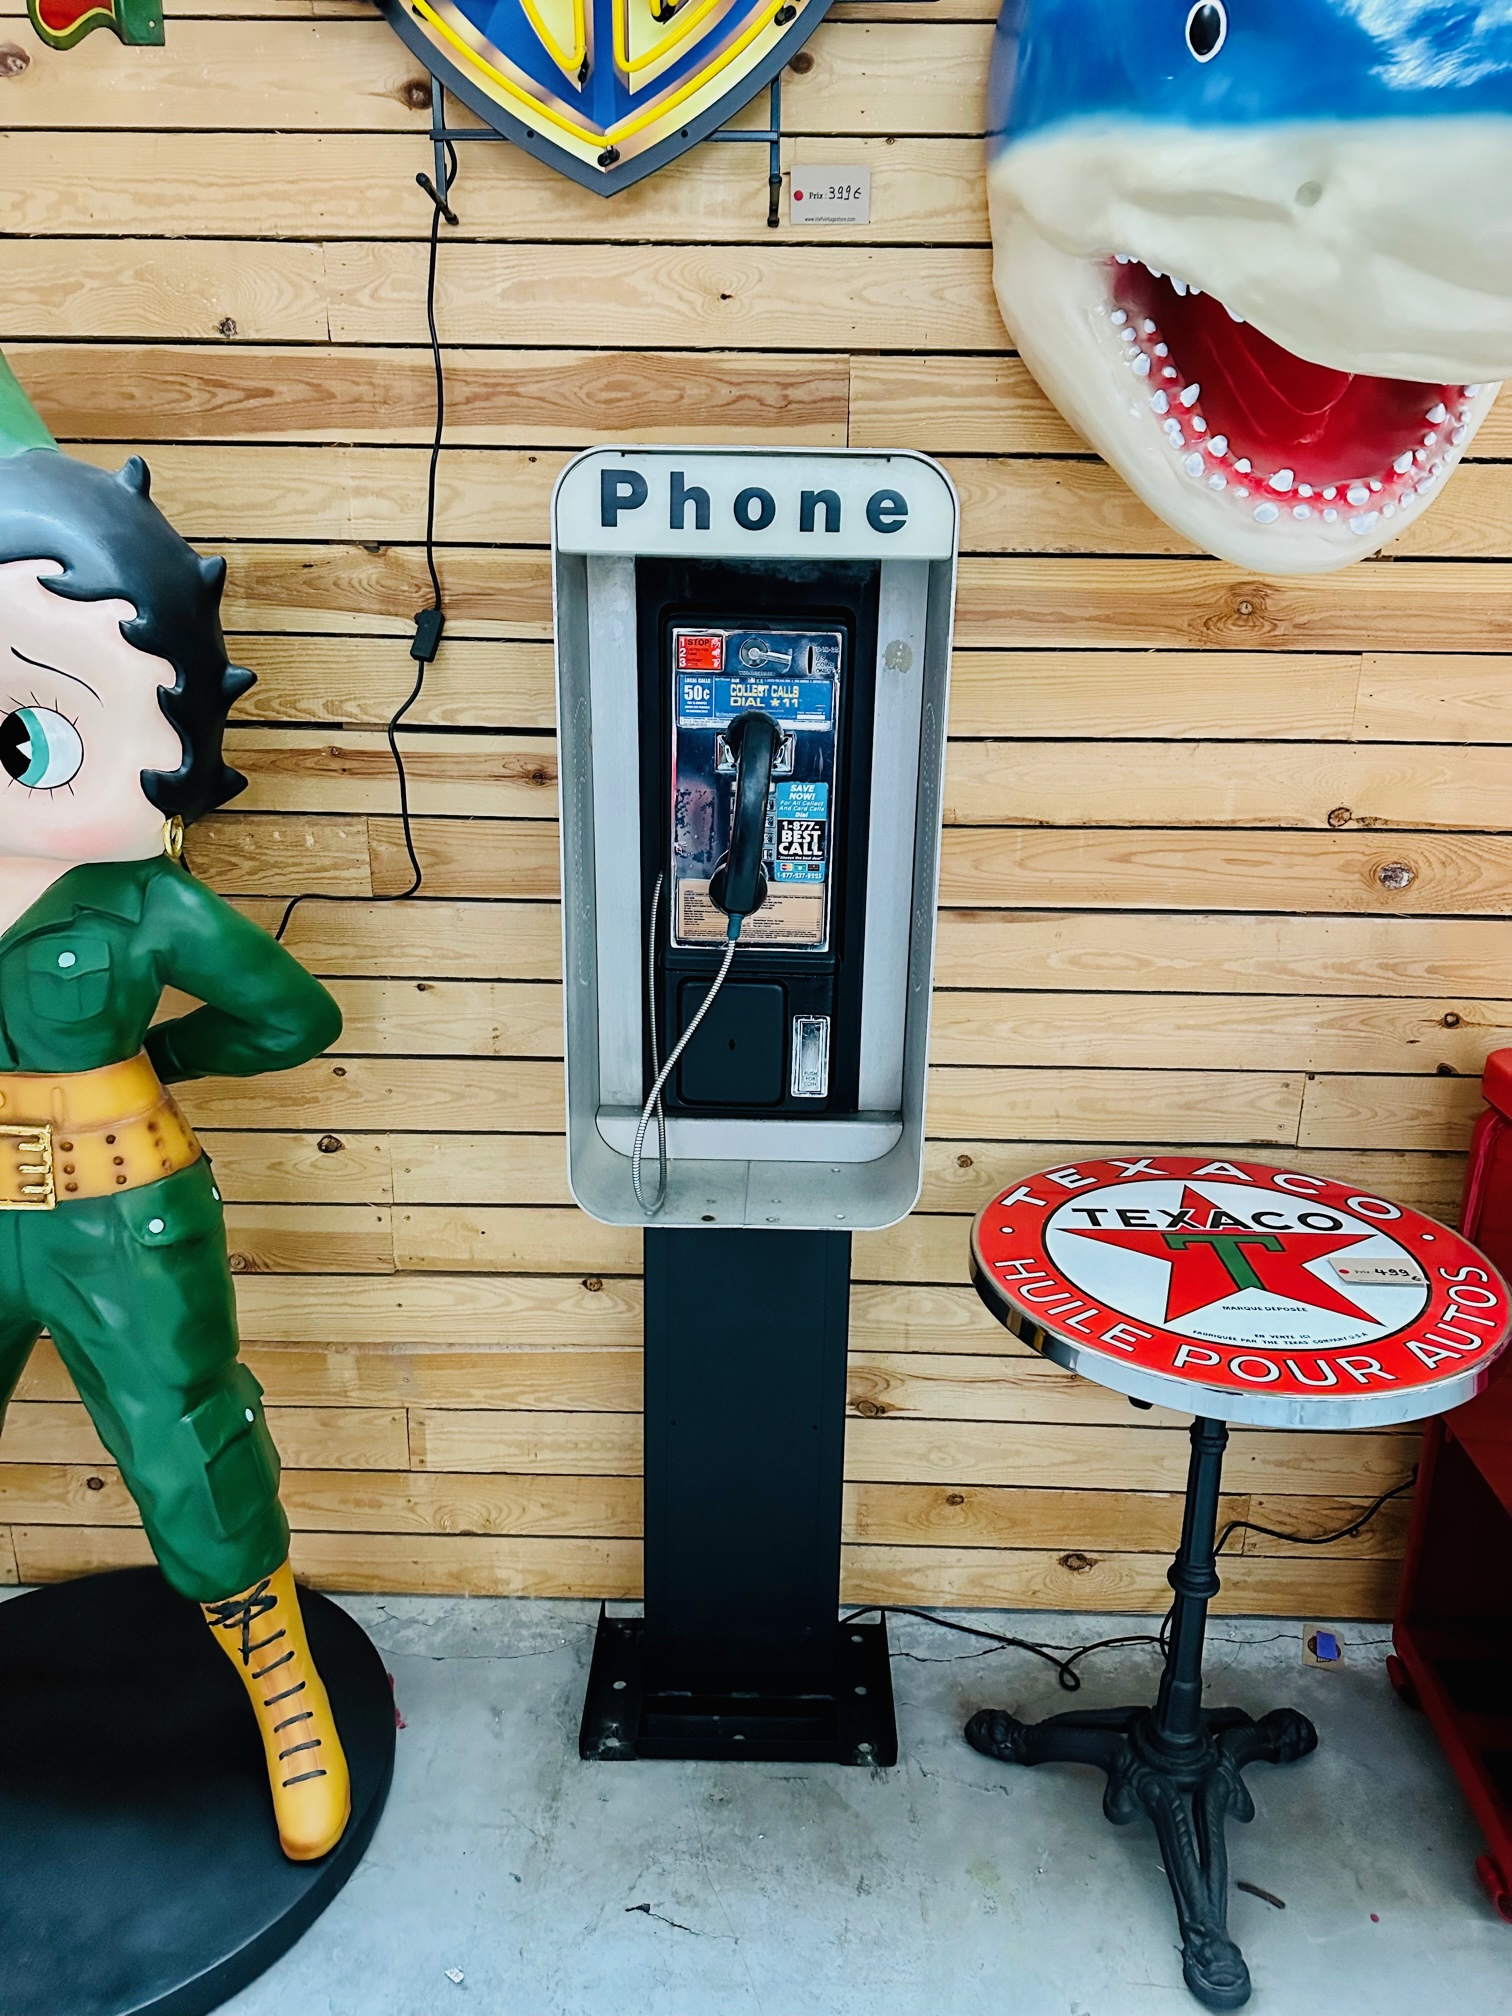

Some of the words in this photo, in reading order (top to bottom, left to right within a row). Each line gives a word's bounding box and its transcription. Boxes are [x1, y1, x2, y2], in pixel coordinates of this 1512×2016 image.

[600, 468, 909, 534] Phone
[687, 638, 710, 646] STOP
[683, 684, 711, 701] 50¢
[730, 684, 769, 697] COLLECT
[771, 685, 800, 698] CALLS
[729, 696, 766, 707] DIAL
[789, 784, 815, 793] SAVE
[788, 792, 816, 800] NOW!
[782, 821, 820, 831] 1-877-
[781, 830, 821, 843] BEST
[778, 842, 823, 856] CALL
[1000, 1158, 1403, 1220] TEXACO
[1071, 1207, 1344, 1232] TEXACO
[993, 1258, 1153, 1353] HUILE
[1172, 1343, 1399, 1388] POUR
[1403, 1265, 1499, 1371] AUTOS
